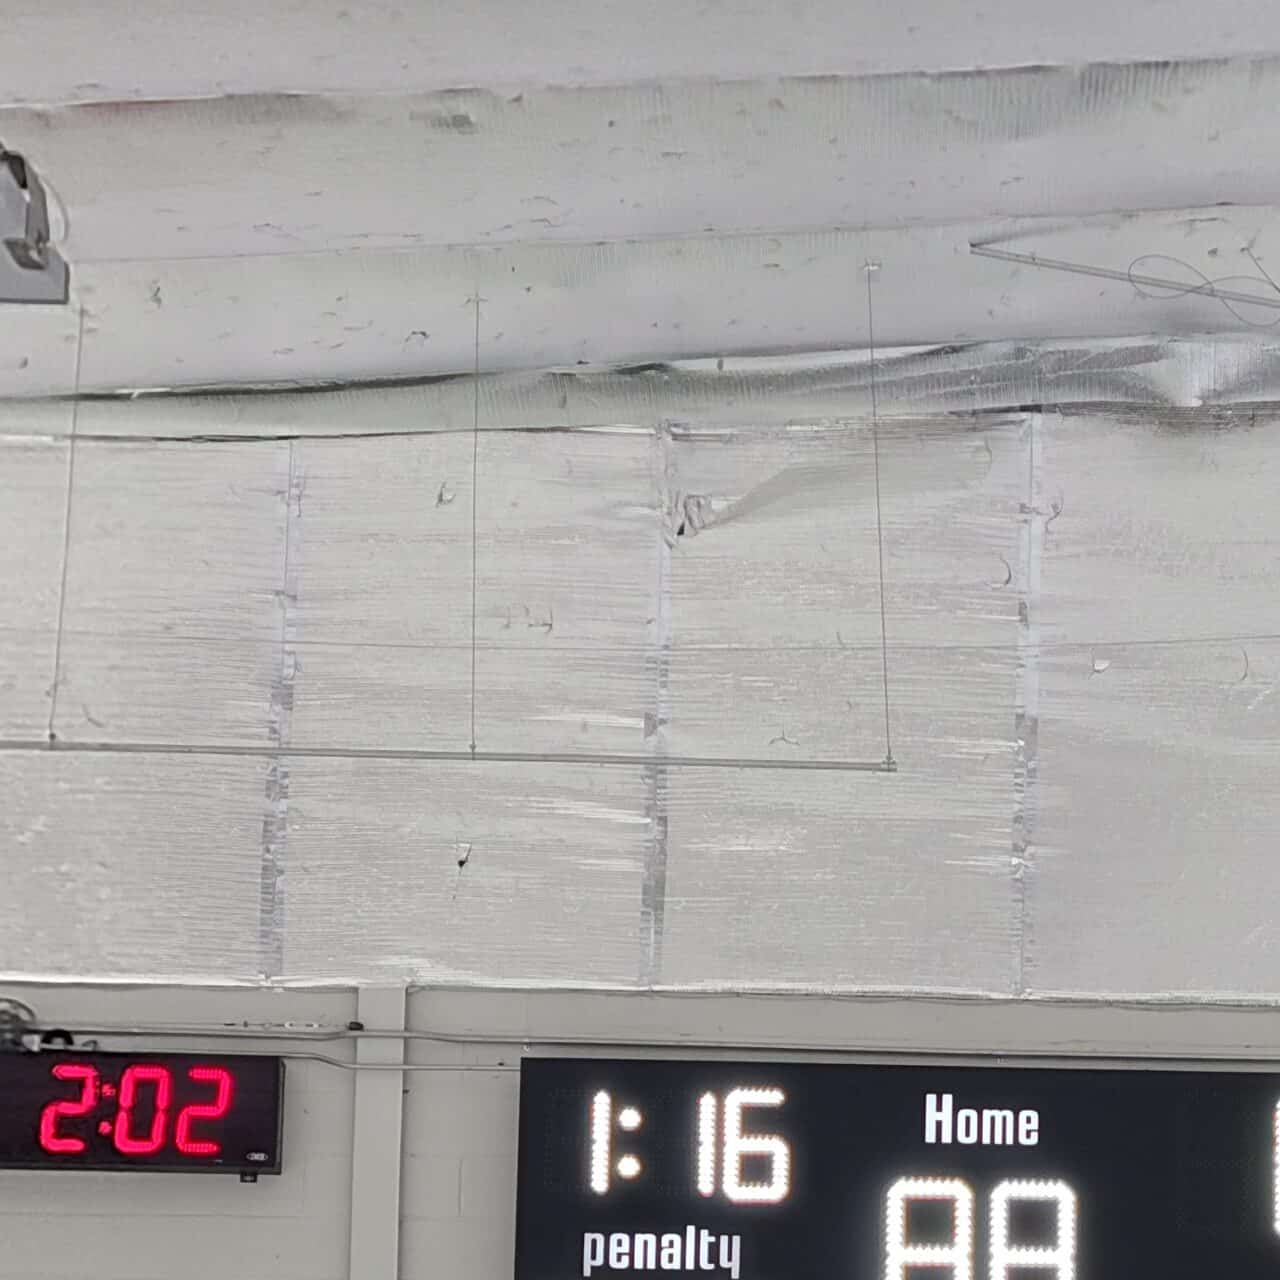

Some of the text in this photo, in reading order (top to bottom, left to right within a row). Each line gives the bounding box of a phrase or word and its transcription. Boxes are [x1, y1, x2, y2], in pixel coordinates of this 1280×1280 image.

[38, 1063, 234, 1155] 2:02
[924, 1092, 1040, 1146] Home
[582, 1224, 741, 1280] penalty
